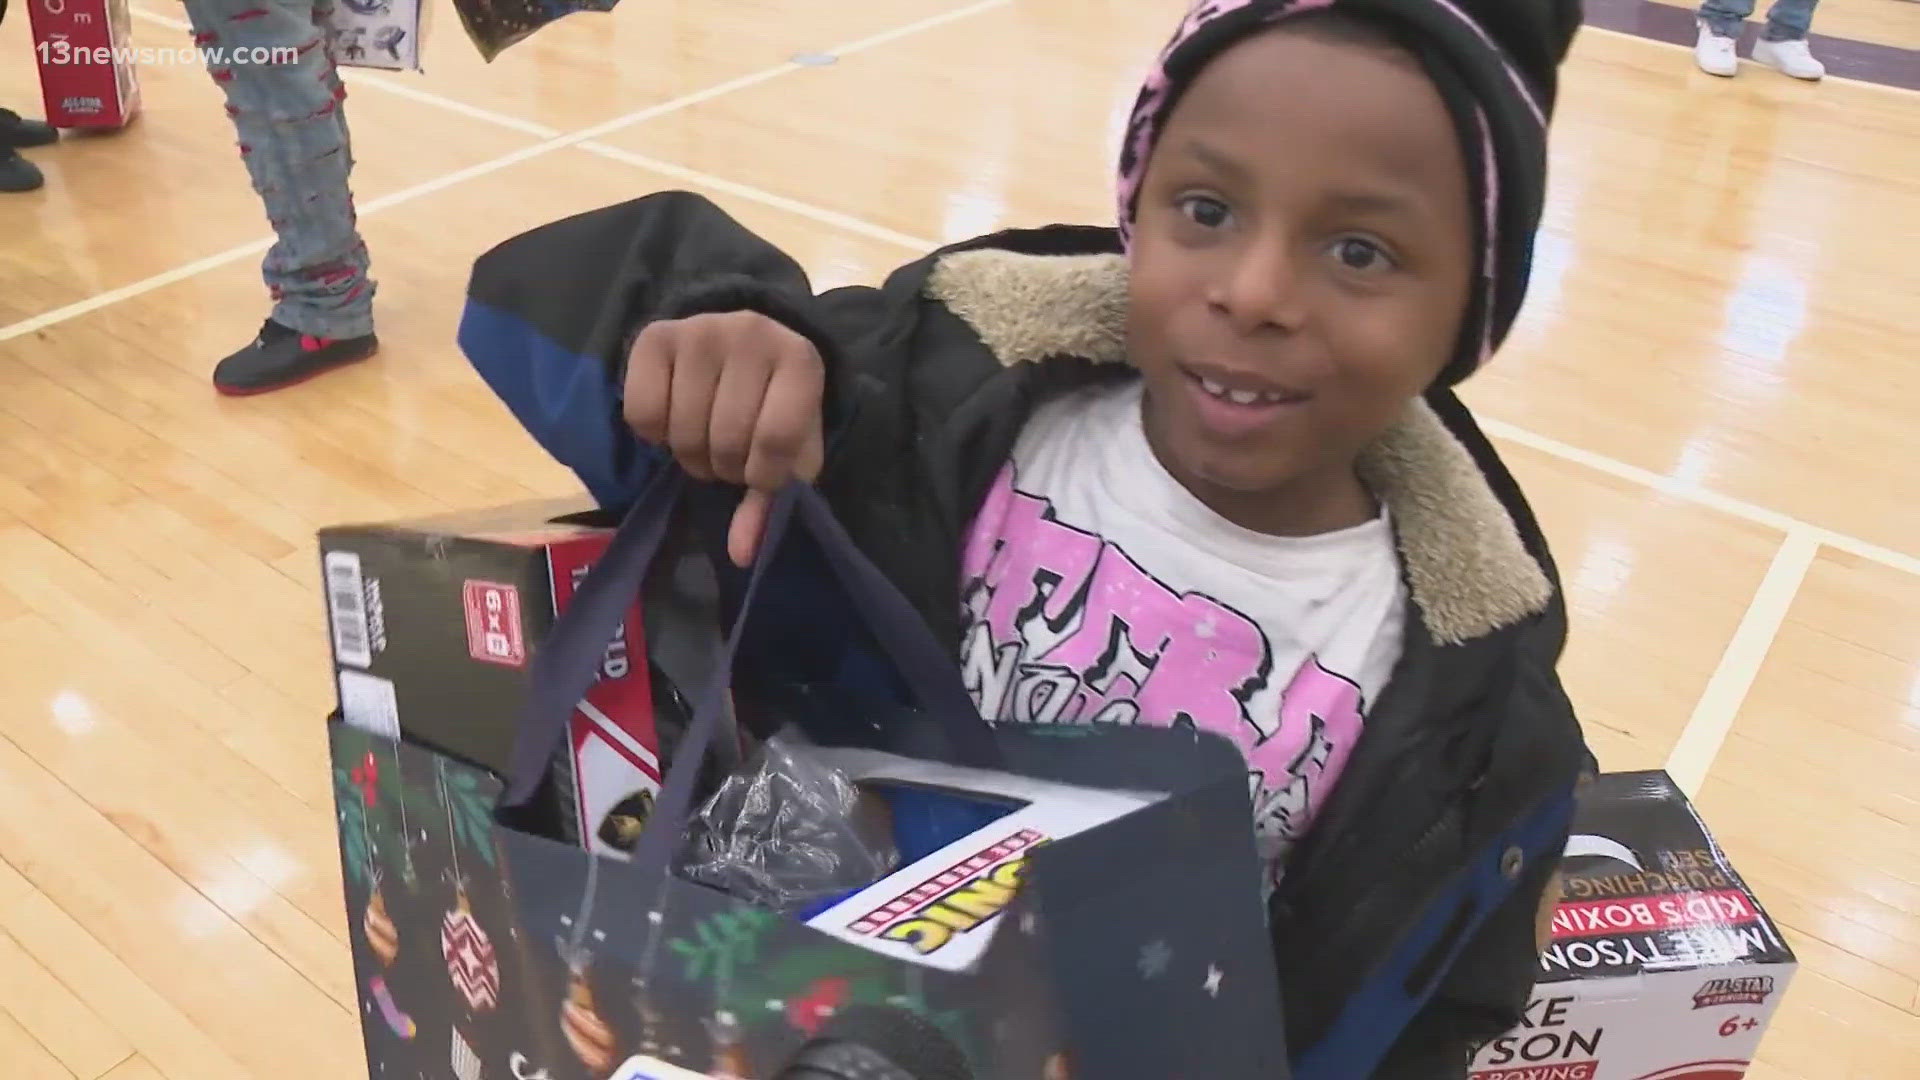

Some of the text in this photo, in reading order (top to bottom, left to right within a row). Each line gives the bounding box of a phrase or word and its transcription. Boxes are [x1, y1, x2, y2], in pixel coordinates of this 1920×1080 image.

[1572, 869, 1725, 898] PUNCHING
[1551, 895, 1749, 934] KID'S BOXIN
[1540, 926, 1767, 972] MKE TYSON
[1519, 995, 1574, 1028] KE
[1718, 1014, 1759, 1037] 6+
[1467, 1028, 1604, 1068] YSON
